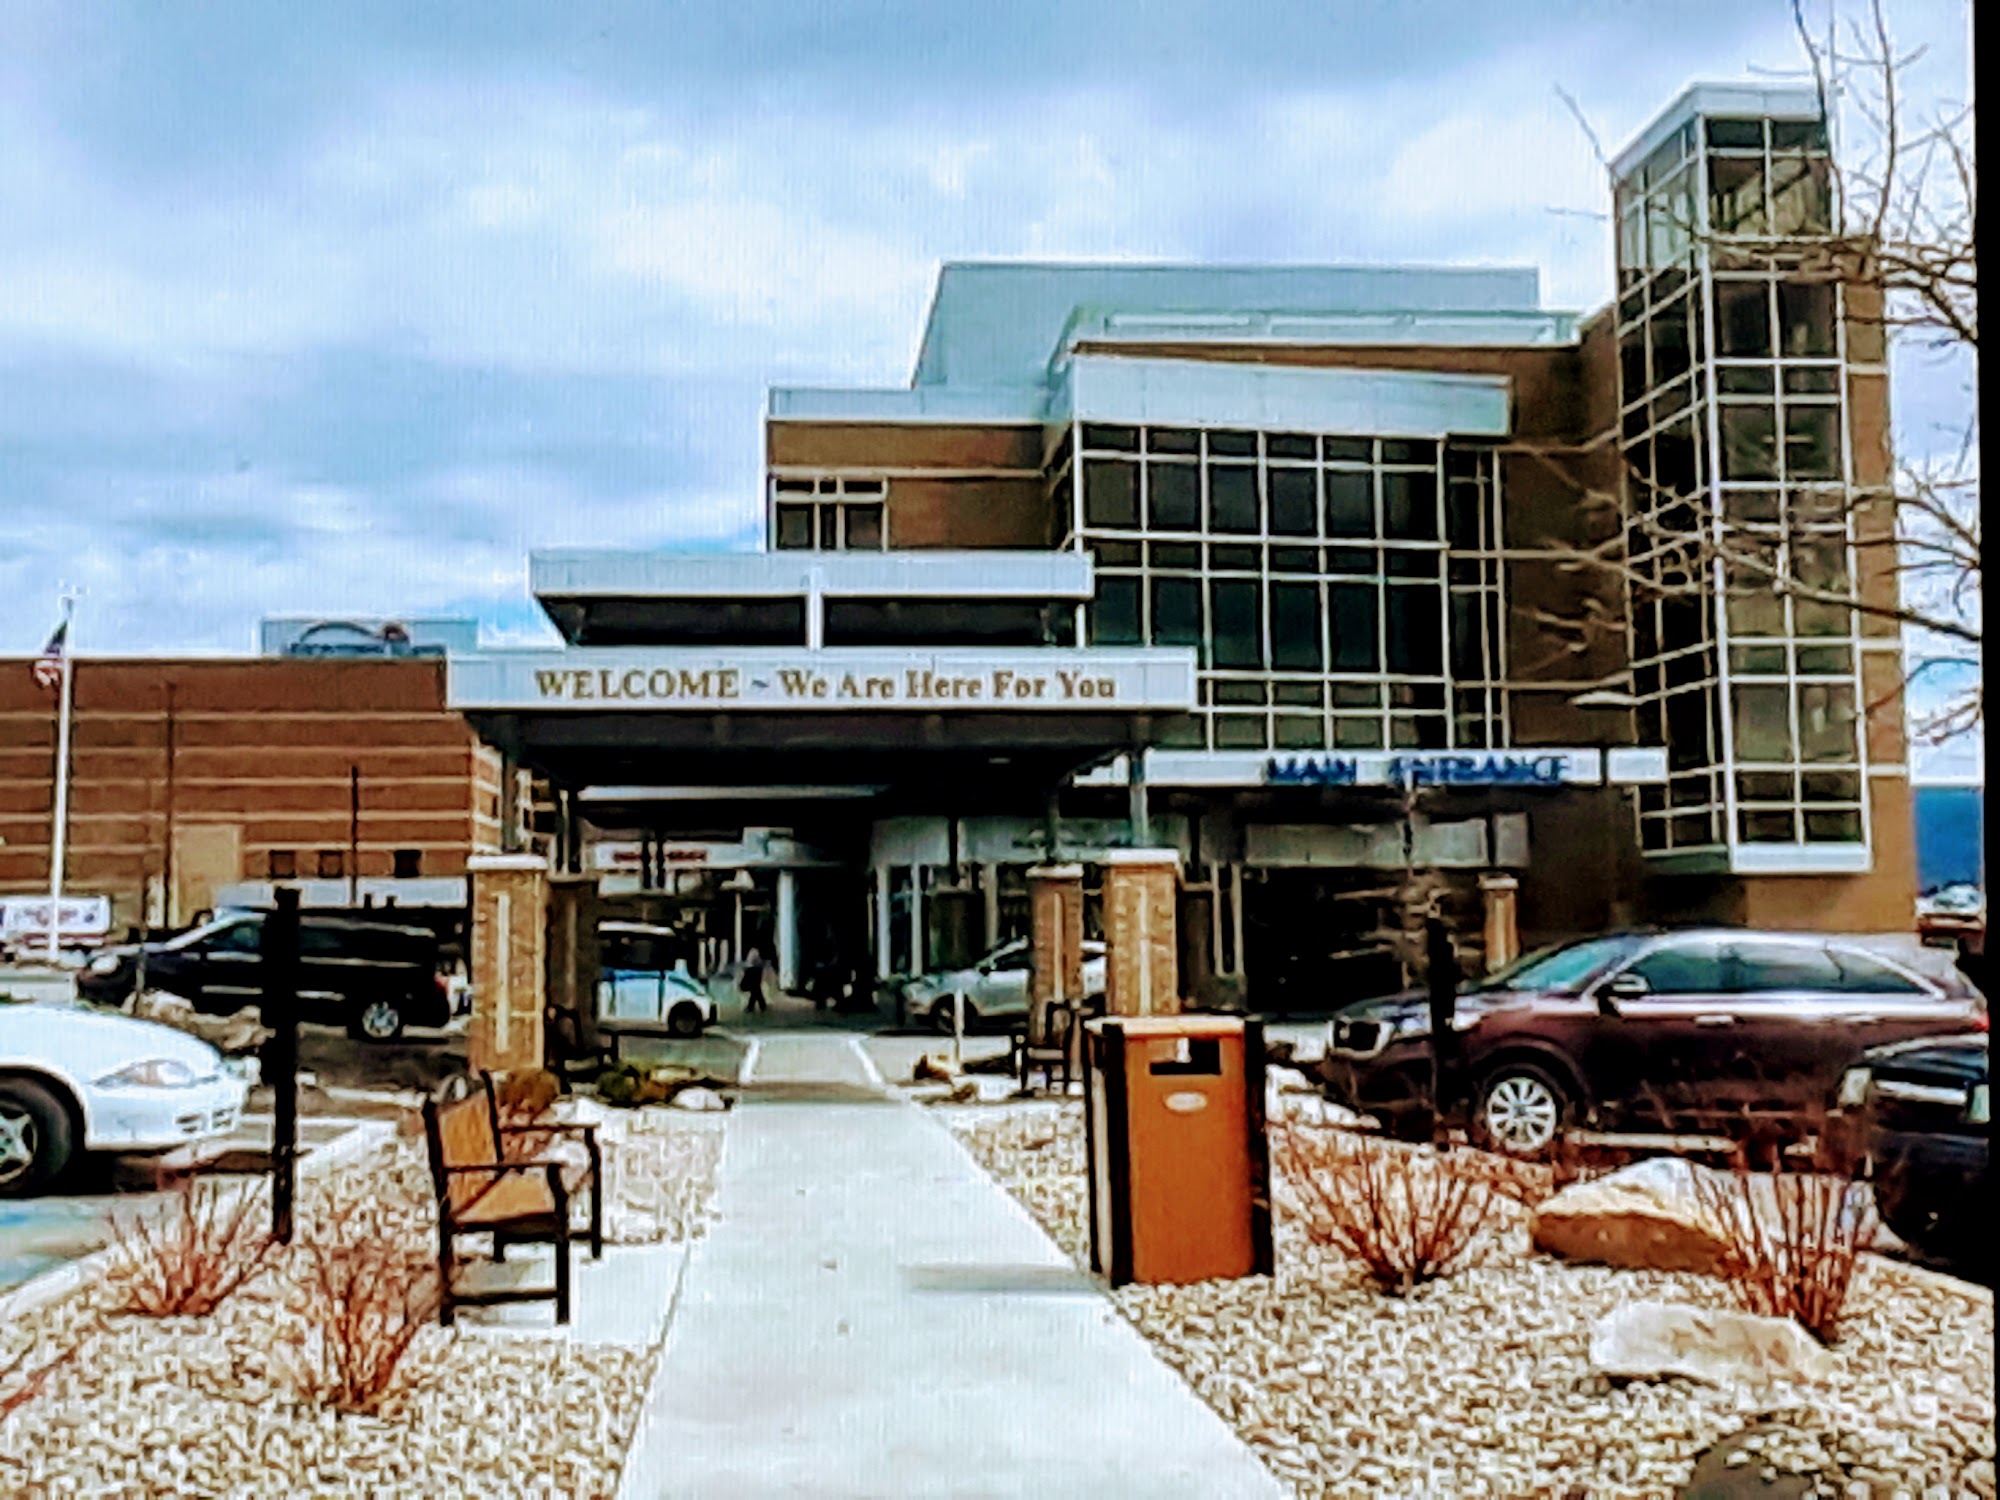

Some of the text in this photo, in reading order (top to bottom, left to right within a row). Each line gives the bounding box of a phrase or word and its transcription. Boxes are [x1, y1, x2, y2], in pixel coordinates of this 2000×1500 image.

[534, 668, 739, 699] WELCOME
[777, 669, 828, 699] We
[837, 671, 895, 699] Are
[905, 669, 982, 699] Here
[991, 670, 1046, 699] For
[1056, 671, 1116, 699] You
[1266, 756, 1357, 785] MAIN
